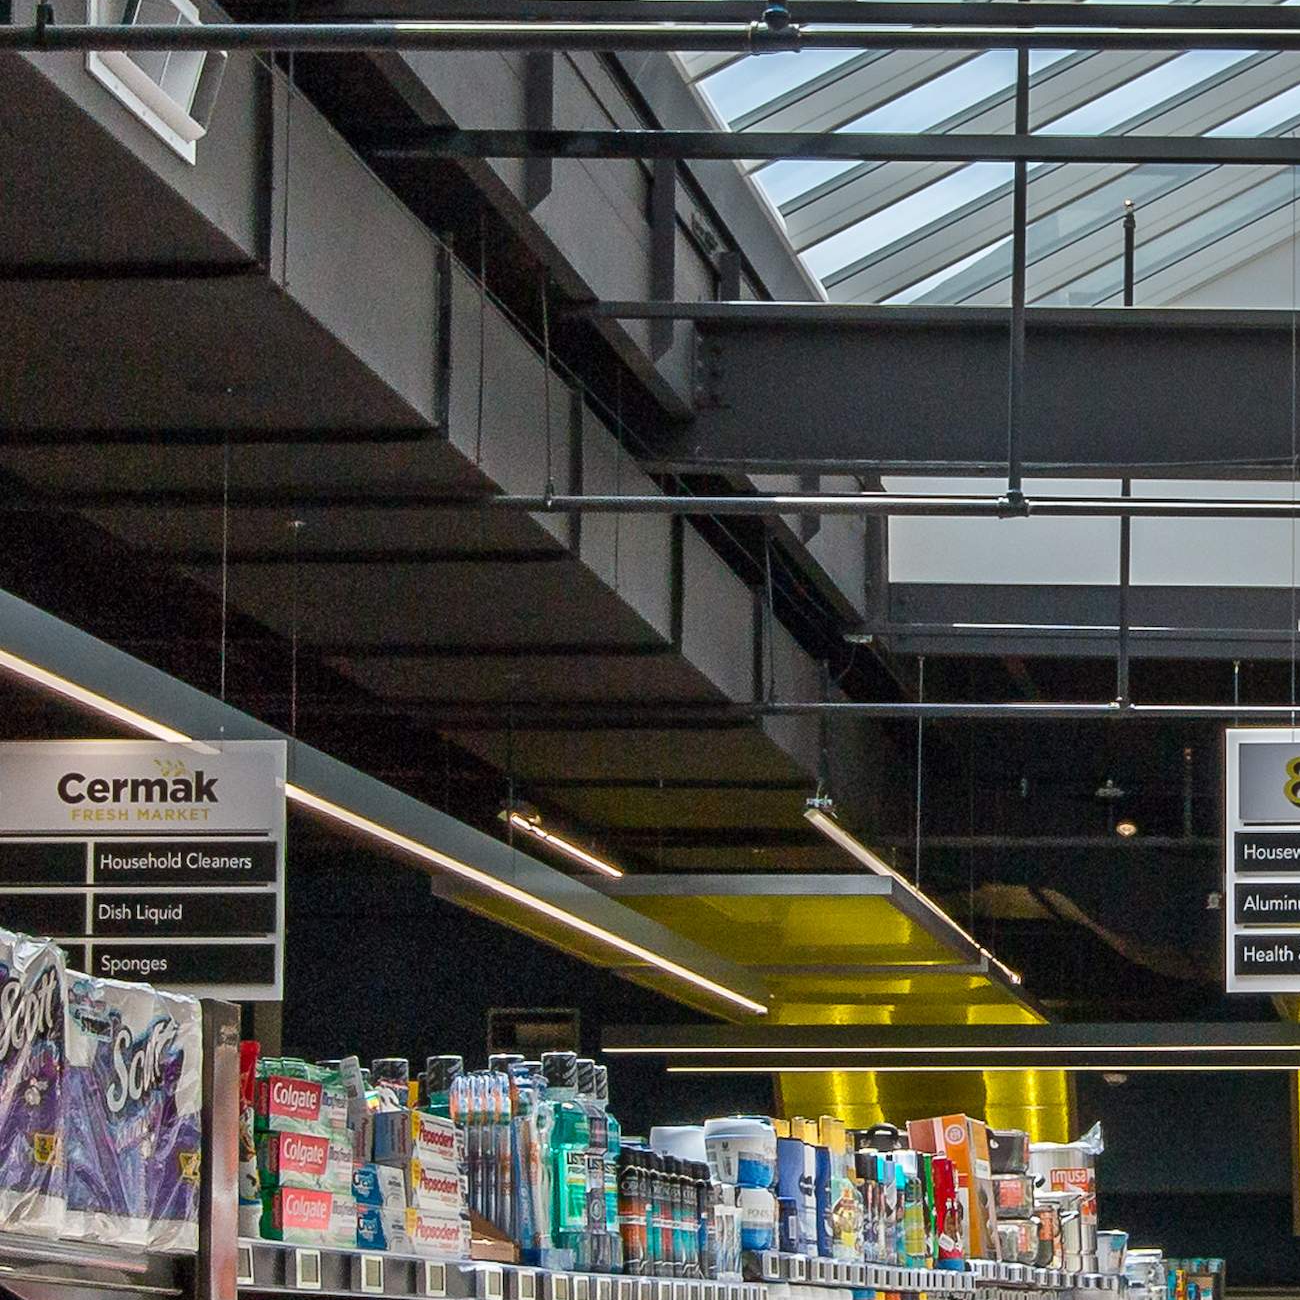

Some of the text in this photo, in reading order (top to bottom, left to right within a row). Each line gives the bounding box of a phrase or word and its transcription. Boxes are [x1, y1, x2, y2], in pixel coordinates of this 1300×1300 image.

[57, 770, 220, 804] Cermak
[71, 808, 211, 821] FRESH MARKET
[101, 852, 252, 870] Household Cleaners
[98, 904, 182, 924] Dish Liquid
[101, 955, 167, 974] Sponges
[1243, 946, 1293, 962] Health
[273, 1082, 318, 1111] Colgate
[418, 1120, 455, 1148] Pepsodent
[283, 1138, 324, 1165] Colgate
[420, 1168, 459, 1195] Pepsodent
[286, 1195, 327, 1221] Colgate
[415, 1216, 460, 1241] Pepsodent
